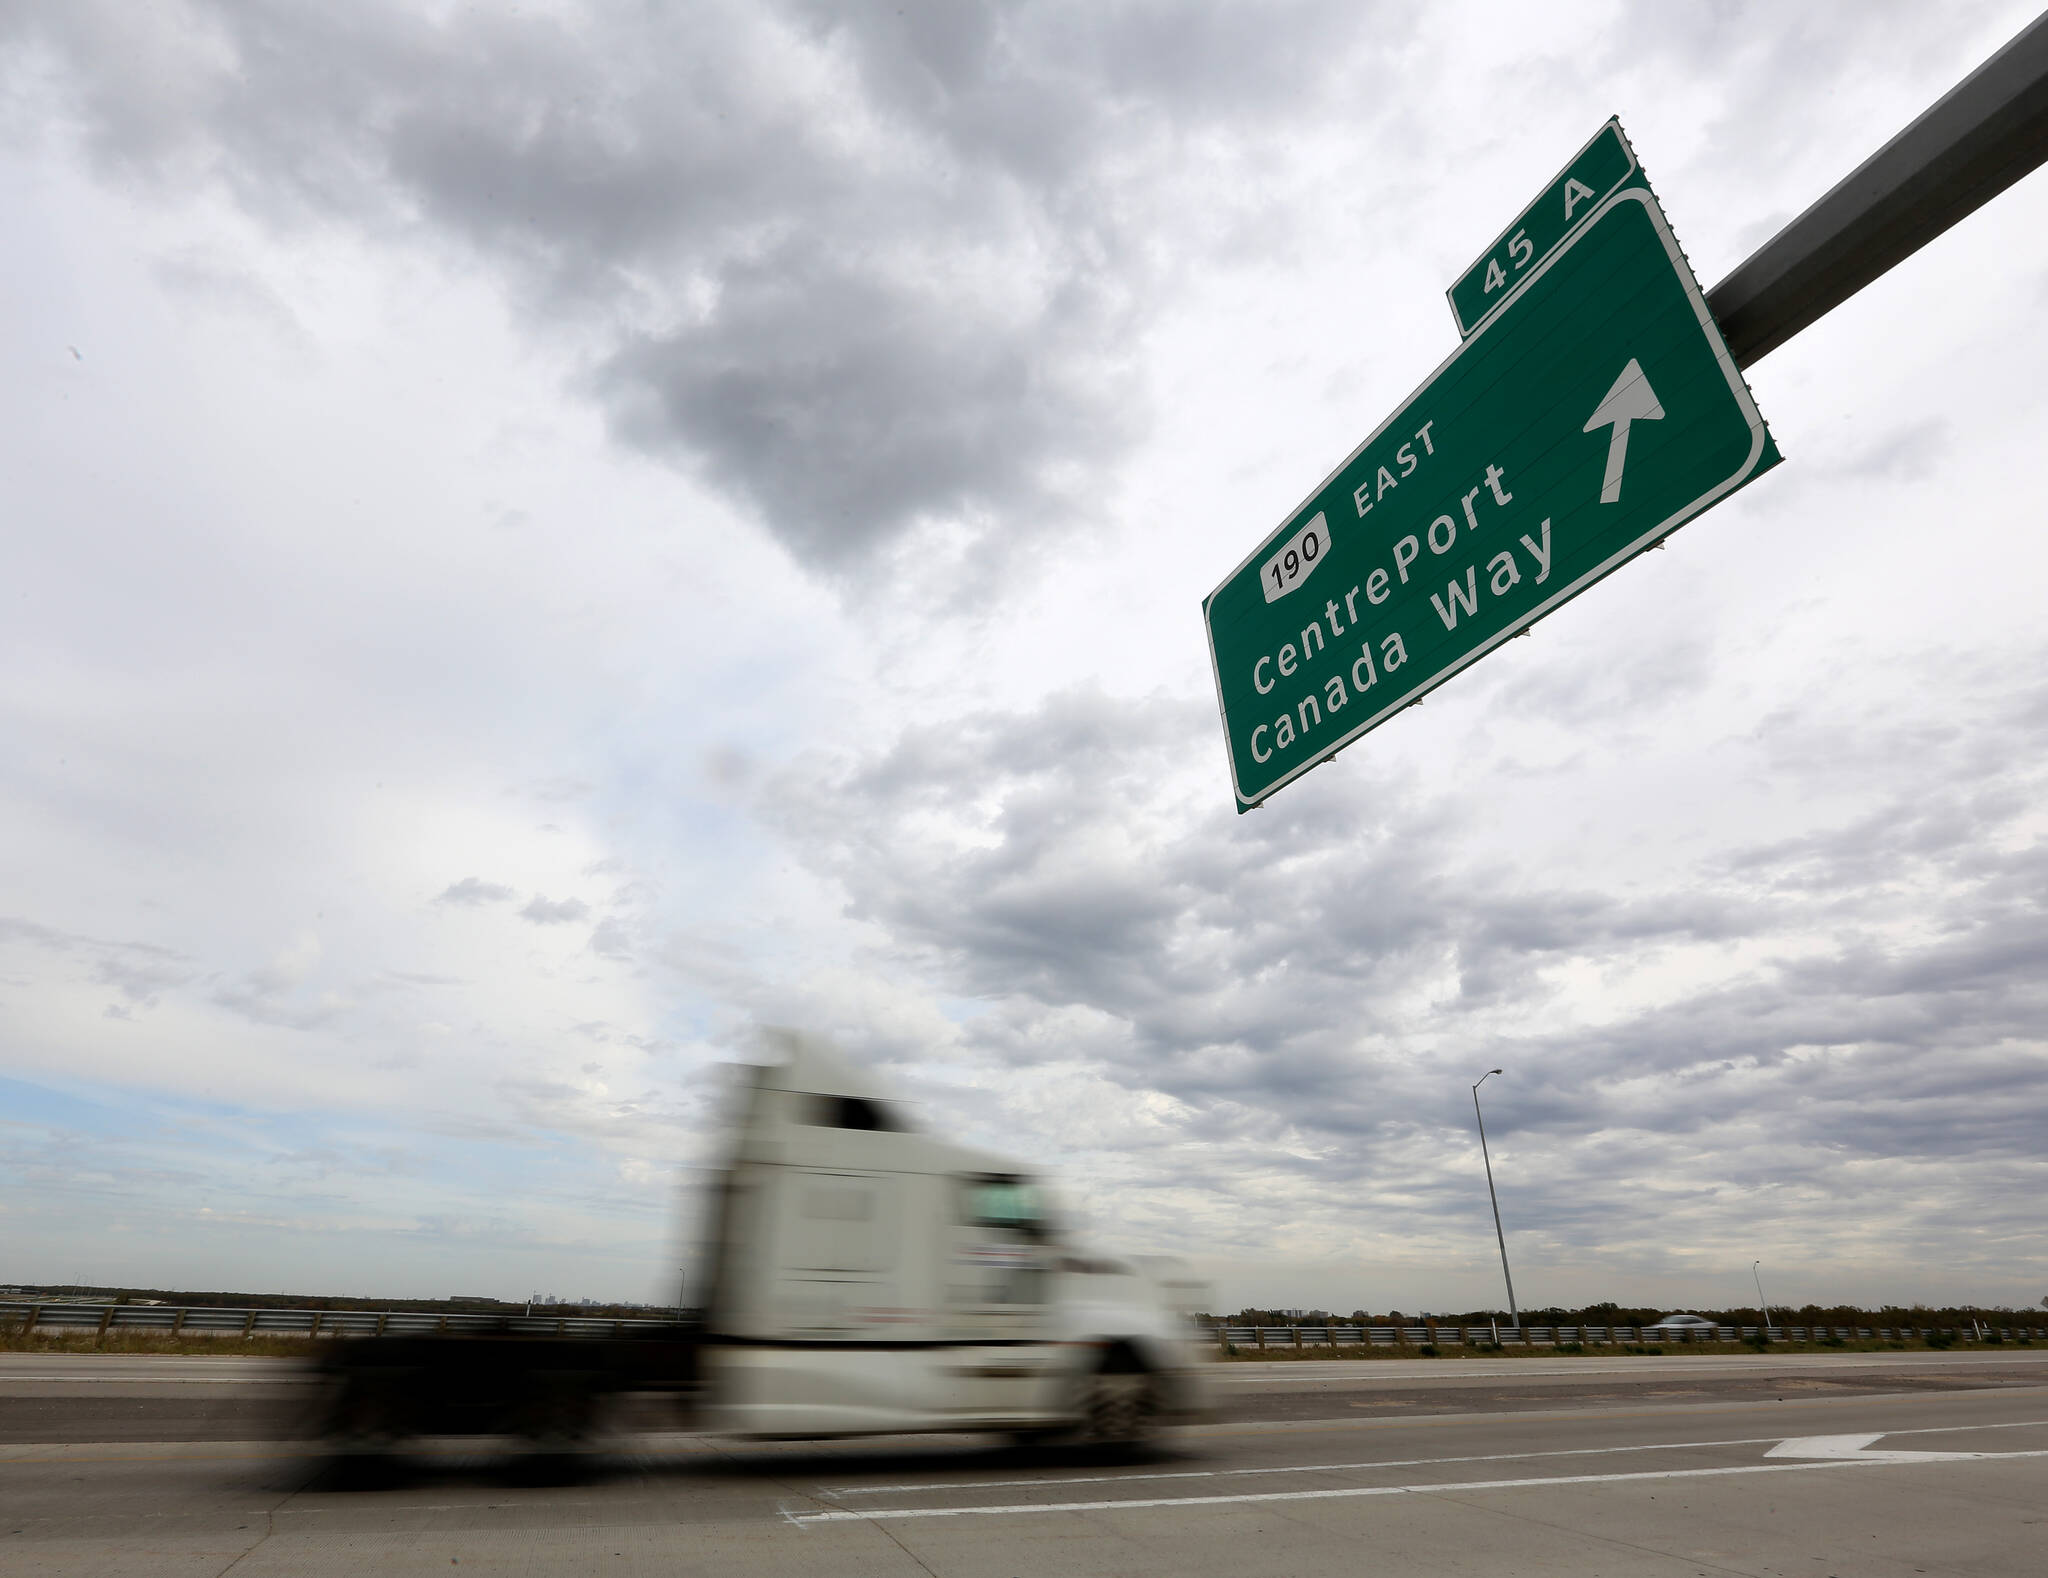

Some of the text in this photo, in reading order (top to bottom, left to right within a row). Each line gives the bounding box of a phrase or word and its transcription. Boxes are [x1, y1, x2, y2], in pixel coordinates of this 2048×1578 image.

[1483, 177, 1596, 295] 45 A
[1253, 464, 1513, 695] CentrePort
[1271, 420, 1435, 589] 190 EAST
[1251, 517, 1551, 764] Canada Way
